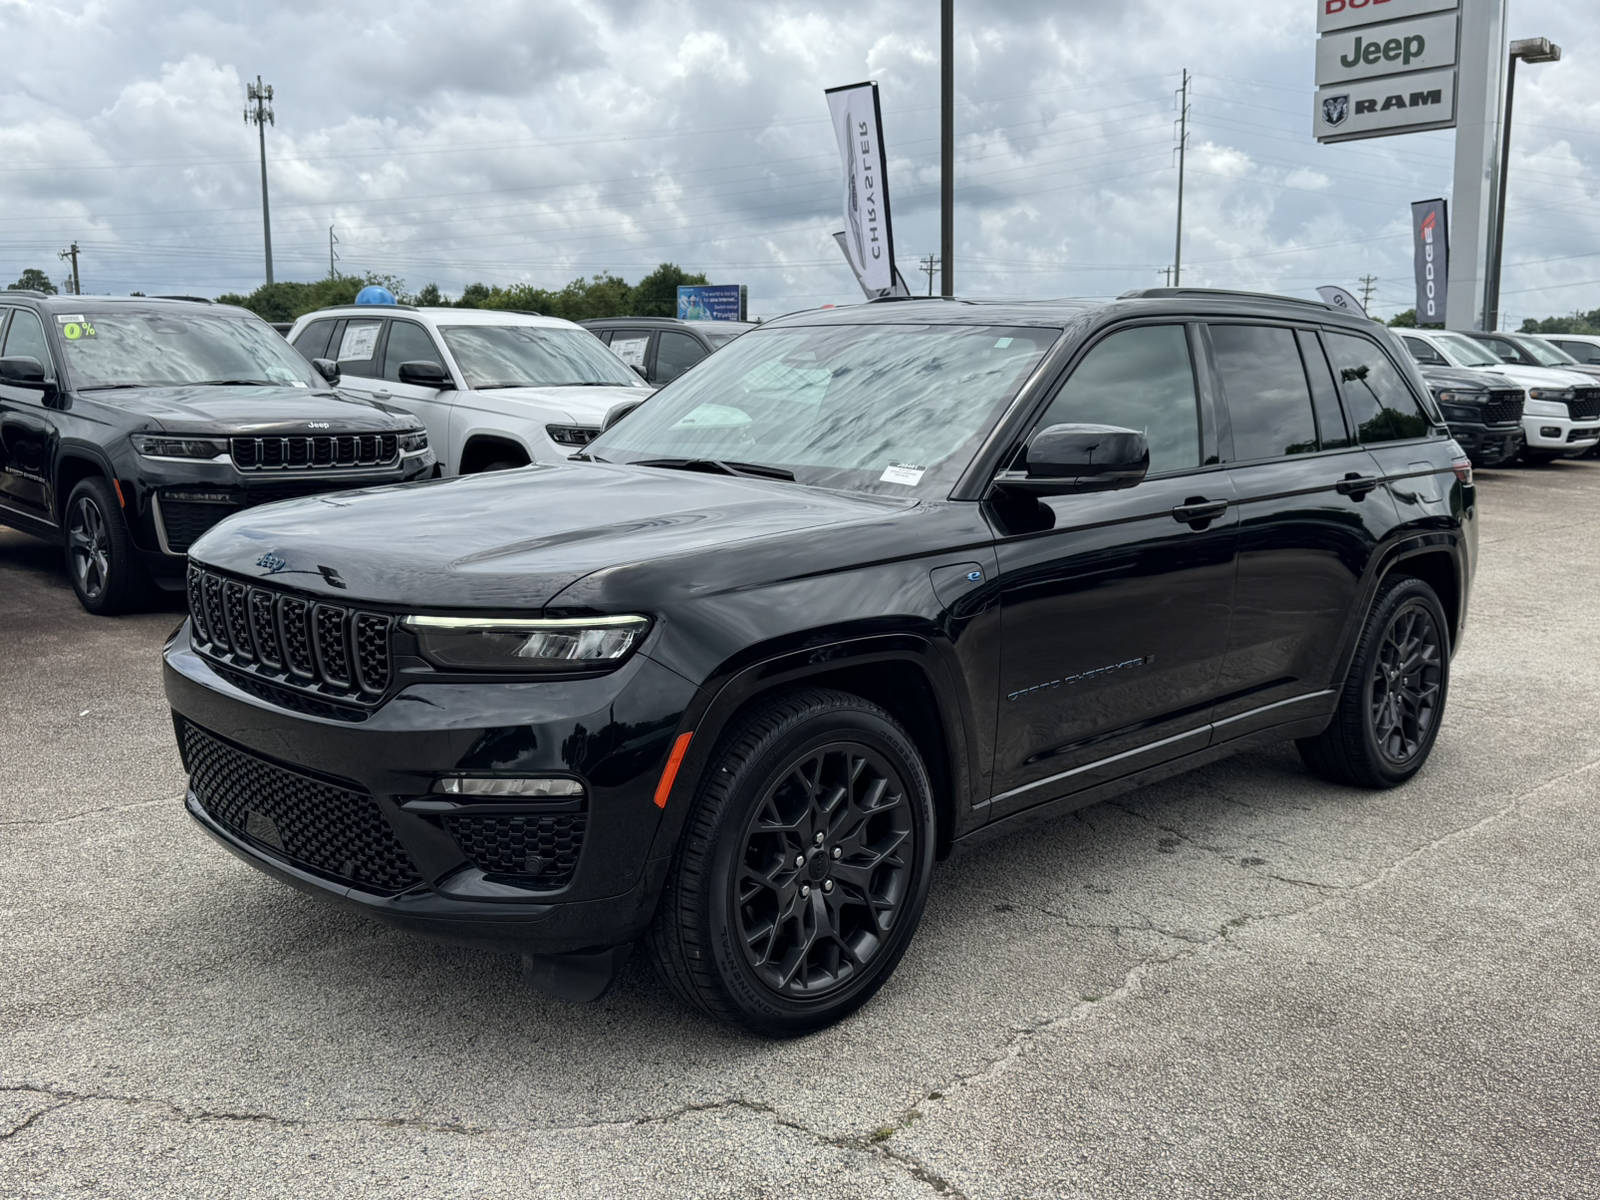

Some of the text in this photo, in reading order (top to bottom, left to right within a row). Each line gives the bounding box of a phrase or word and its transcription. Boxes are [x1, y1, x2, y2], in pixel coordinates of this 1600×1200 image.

[1340, 34, 1425, 68] Jeep
[1354, 89, 1442, 115] RAM
[1425, 227, 1435, 316] DODGE
[64, 322, 96, 340] 0%
[308, 421, 330, 430] Jeep
[255, 552, 286, 574] Jeep
[720, 925, 783, 1018] CONTINENTAL
